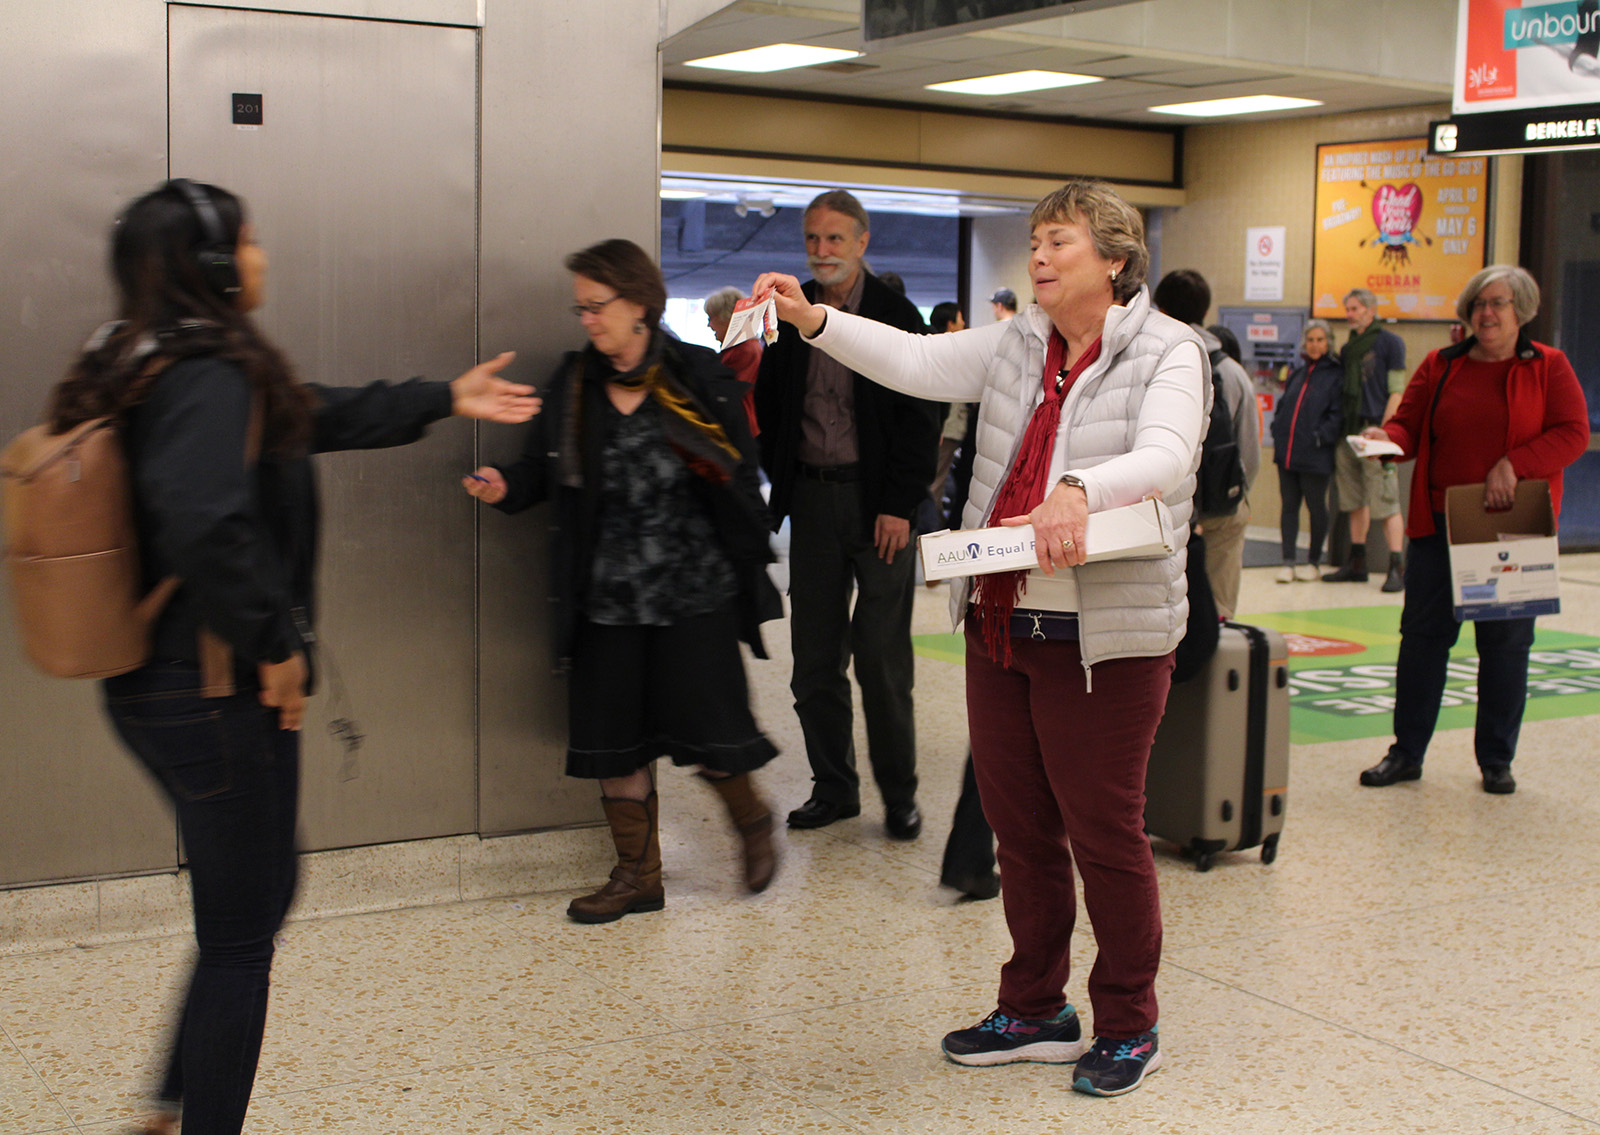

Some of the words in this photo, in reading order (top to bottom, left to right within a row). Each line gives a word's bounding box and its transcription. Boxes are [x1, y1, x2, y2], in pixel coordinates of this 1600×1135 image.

[237, 103, 259, 113] 201
[1384, 163, 1410, 178] MUSIC
[1437, 187, 1464, 203] APRIL
[1436, 216, 1465, 237] MAY
[1467, 216, 1477, 237] 6
[1443, 238, 1469, 254] ONLY
[1366, 275, 1421, 288] CURRAN
[938, 543, 982, 563] AAUW
[987, 541, 1025, 557] Equal
